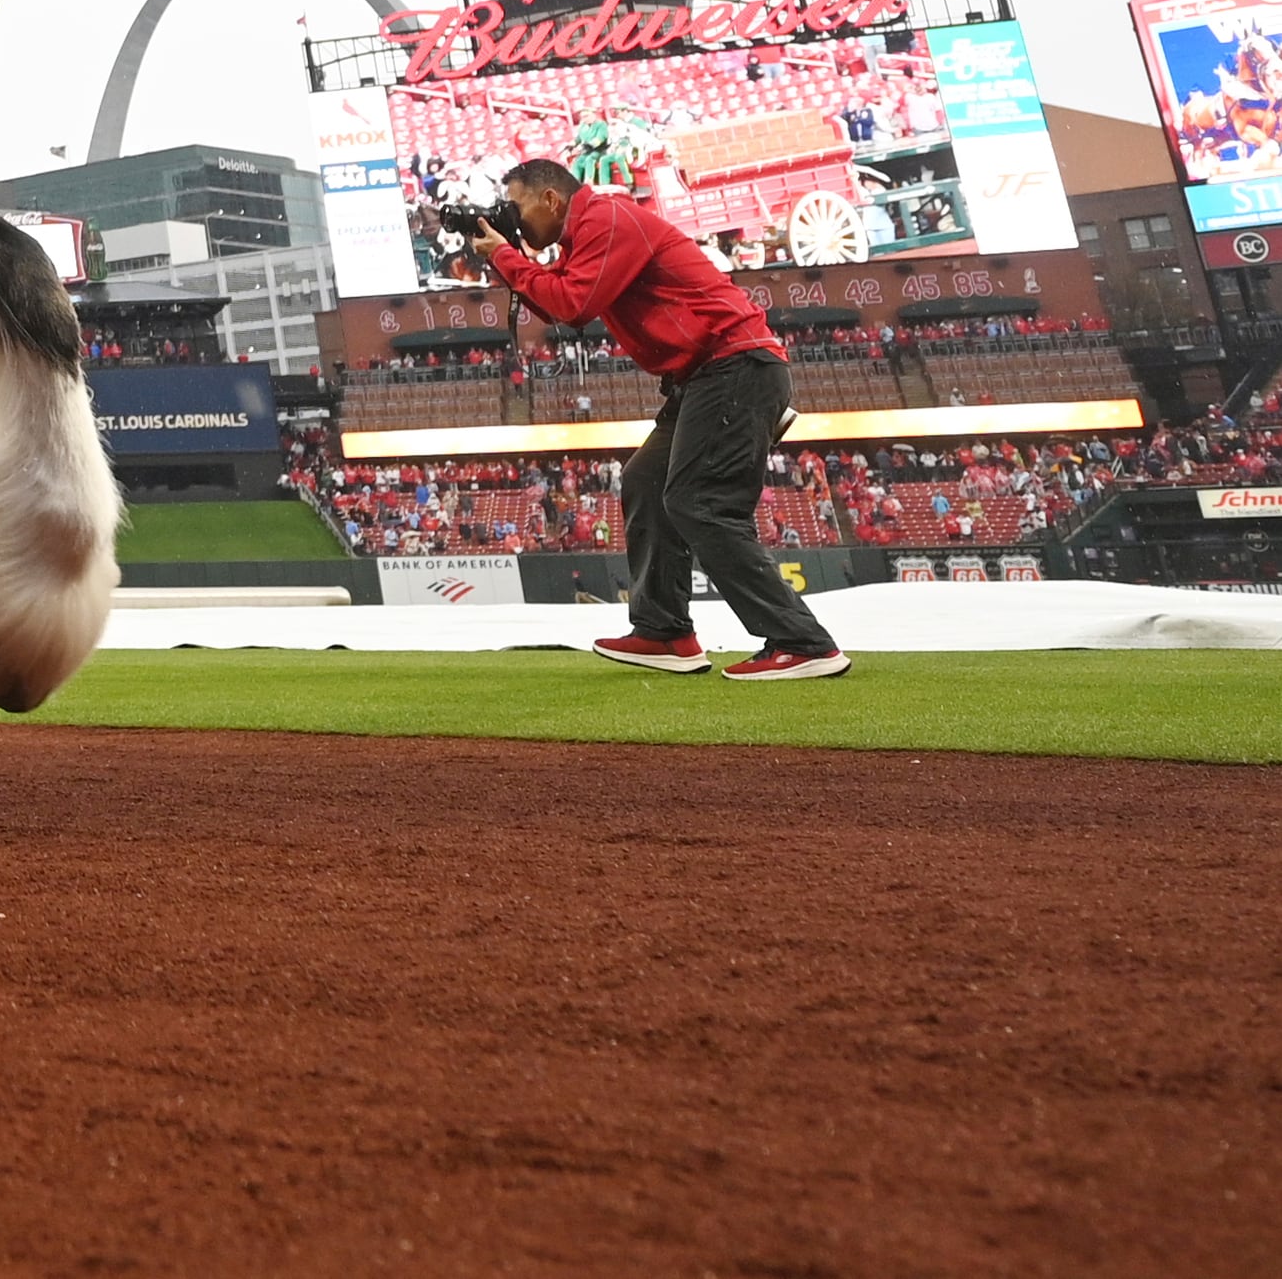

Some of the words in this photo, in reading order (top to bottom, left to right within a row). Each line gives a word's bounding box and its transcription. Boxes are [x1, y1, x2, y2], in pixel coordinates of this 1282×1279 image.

[319, 130, 387, 149] KMOX
[1239, 240, 1263, 255] BC
[844, 278, 884, 305] 42
[902, 274, 941, 301] 45
[952, 271, 993, 298] 85
[788, 281, 827, 308] 24
[424, 305, 435, 330] 1
[448, 305, 468, 329] 2
[479, 302, 498, 327] 6
[120, 415, 164, 430] LOUIS
[165, 412, 249, 429] CARDINALS
[1212, 490, 1282, 508] Schn
[383, 560, 421, 571] BANK
[425, 559, 442, 570] OF
[446, 558, 514, 570] AMERICA
[906, 571, 929, 582] 66
[955, 570, 981, 582] 66
[1009, 570, 1035, 582] 66
